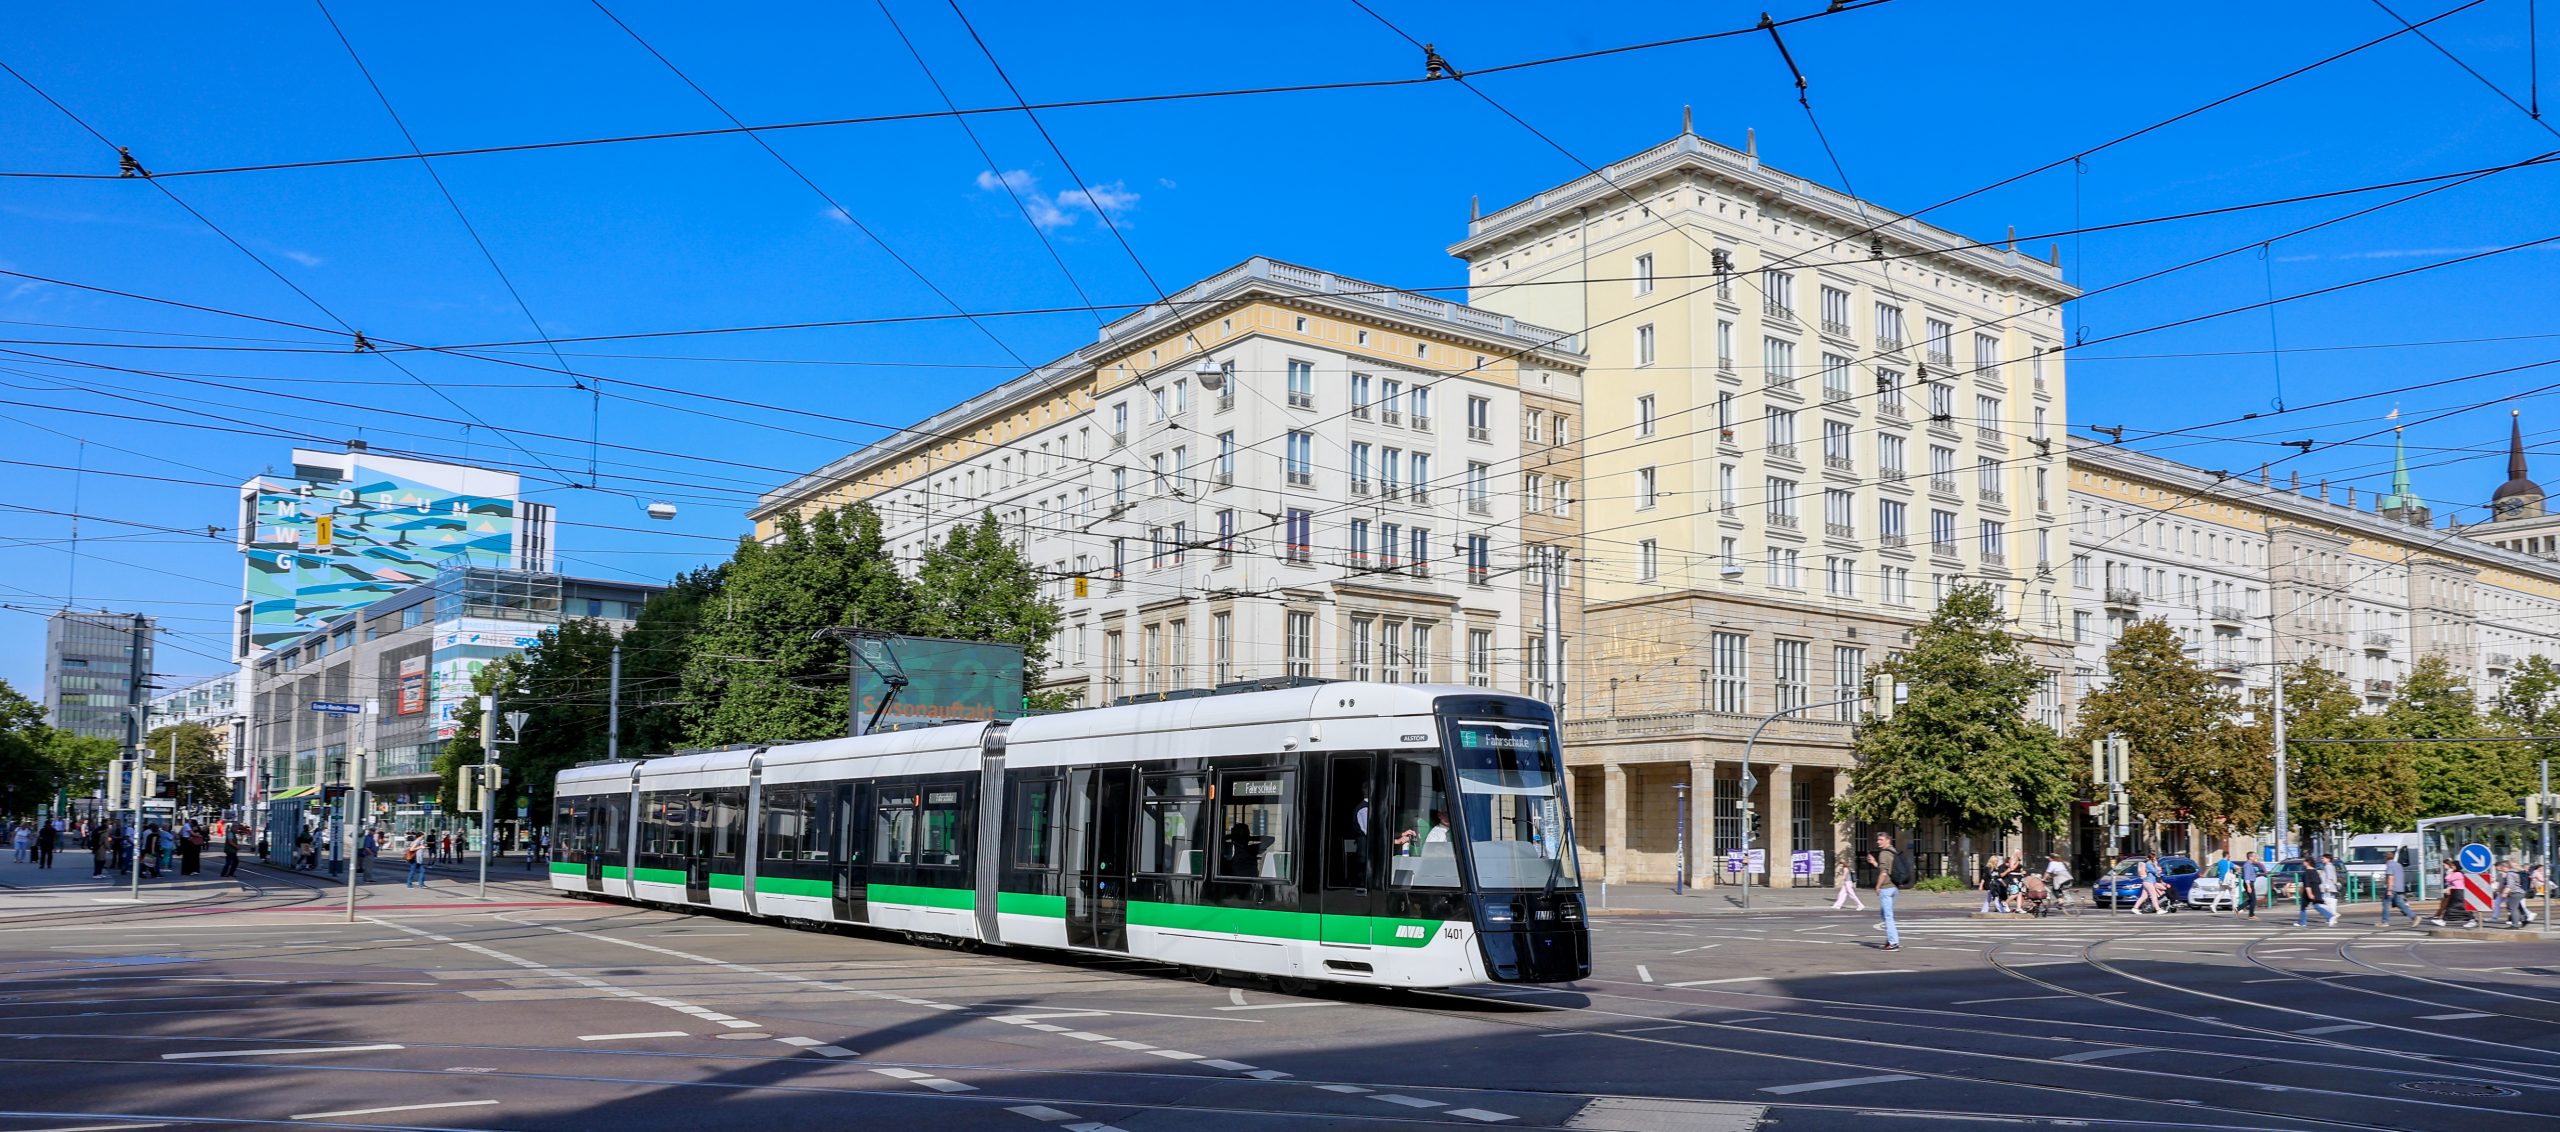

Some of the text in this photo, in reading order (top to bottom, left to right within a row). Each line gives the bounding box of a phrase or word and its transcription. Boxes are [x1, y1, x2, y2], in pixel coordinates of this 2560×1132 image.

[300, 484, 470, 518] FORUM
[1485, 733, 1530, 748] Fahrschule
[1245, 782, 1277, 795] Fahrschule
[1444, 928, 1463, 940] 1401
